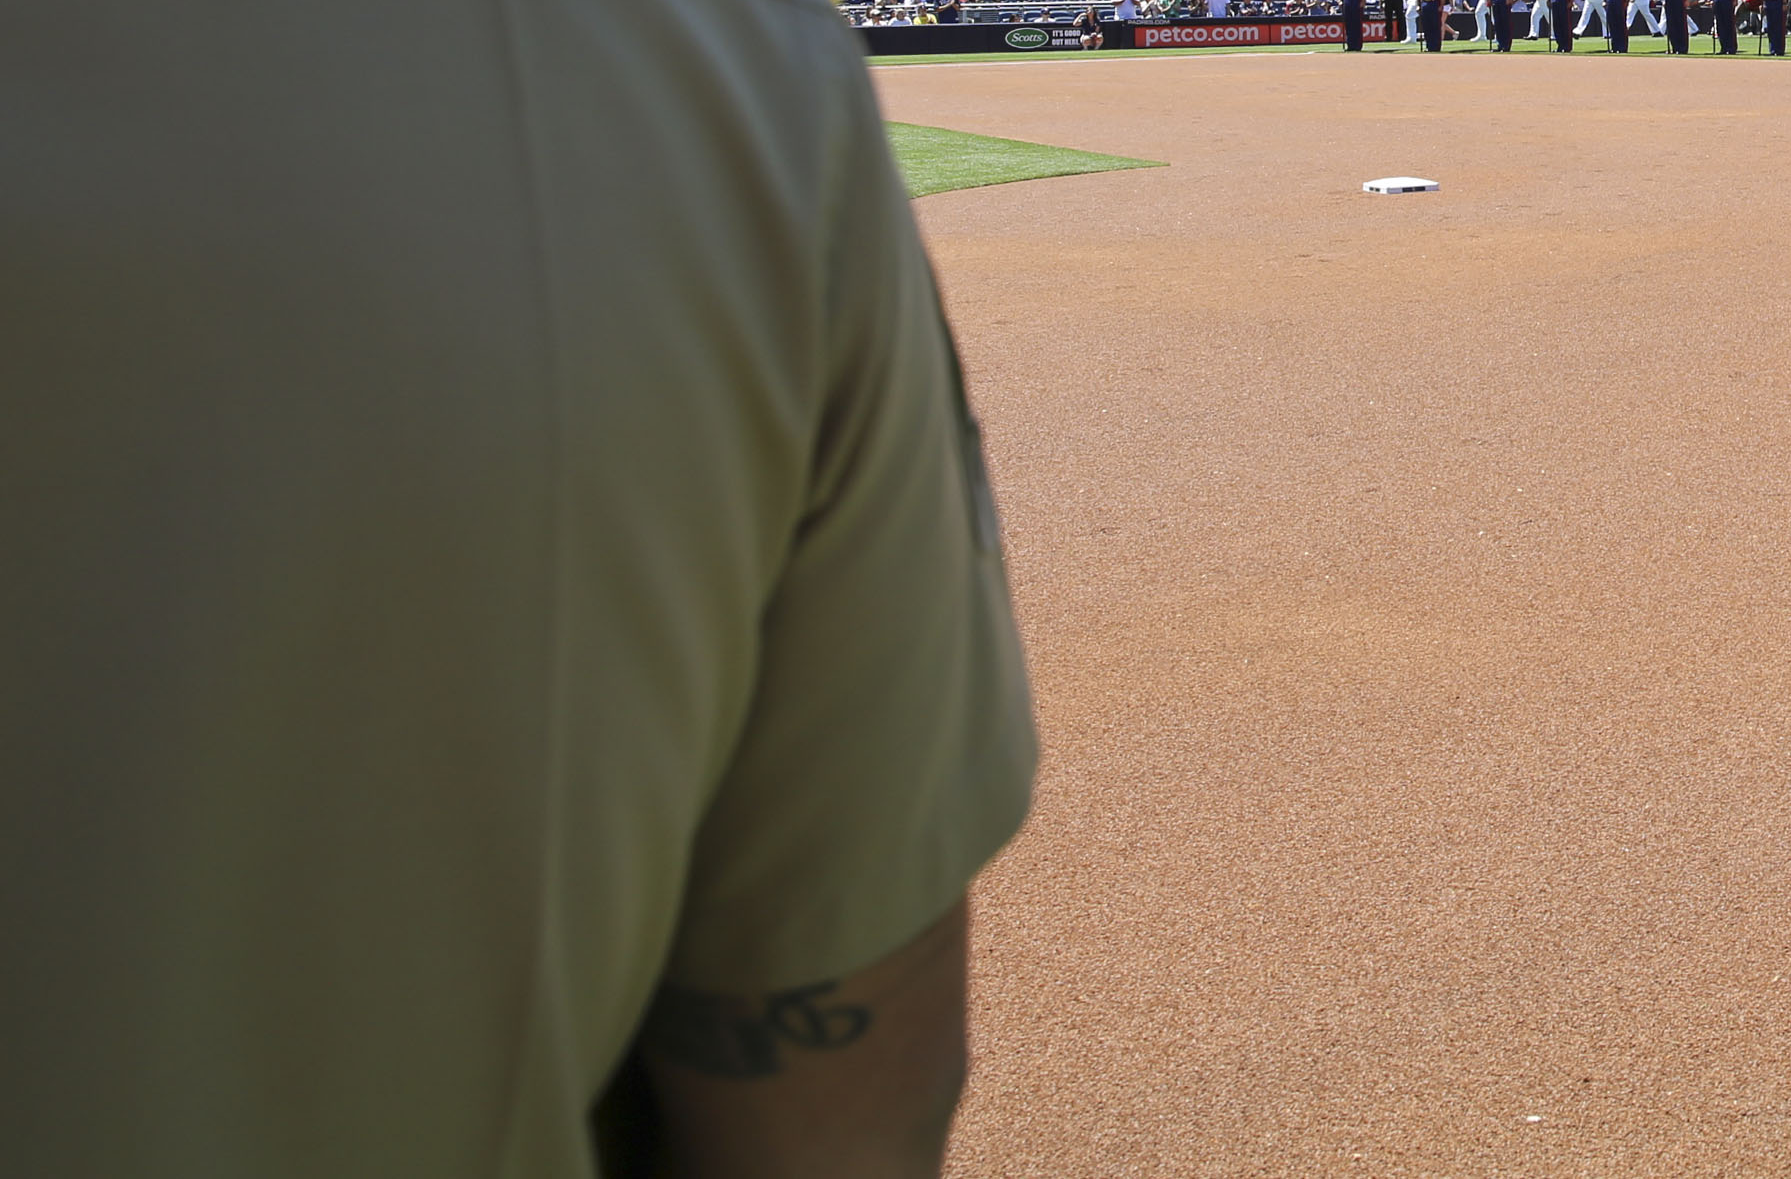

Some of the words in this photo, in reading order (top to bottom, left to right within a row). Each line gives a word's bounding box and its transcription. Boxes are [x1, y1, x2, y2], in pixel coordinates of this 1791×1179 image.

[1011, 33, 1044, 42] Scotts
[1064, 29, 1080, 37] GOOD
[1146, 25, 1258, 46] petco.com
[1281, 23, 1386, 43] petco.om
